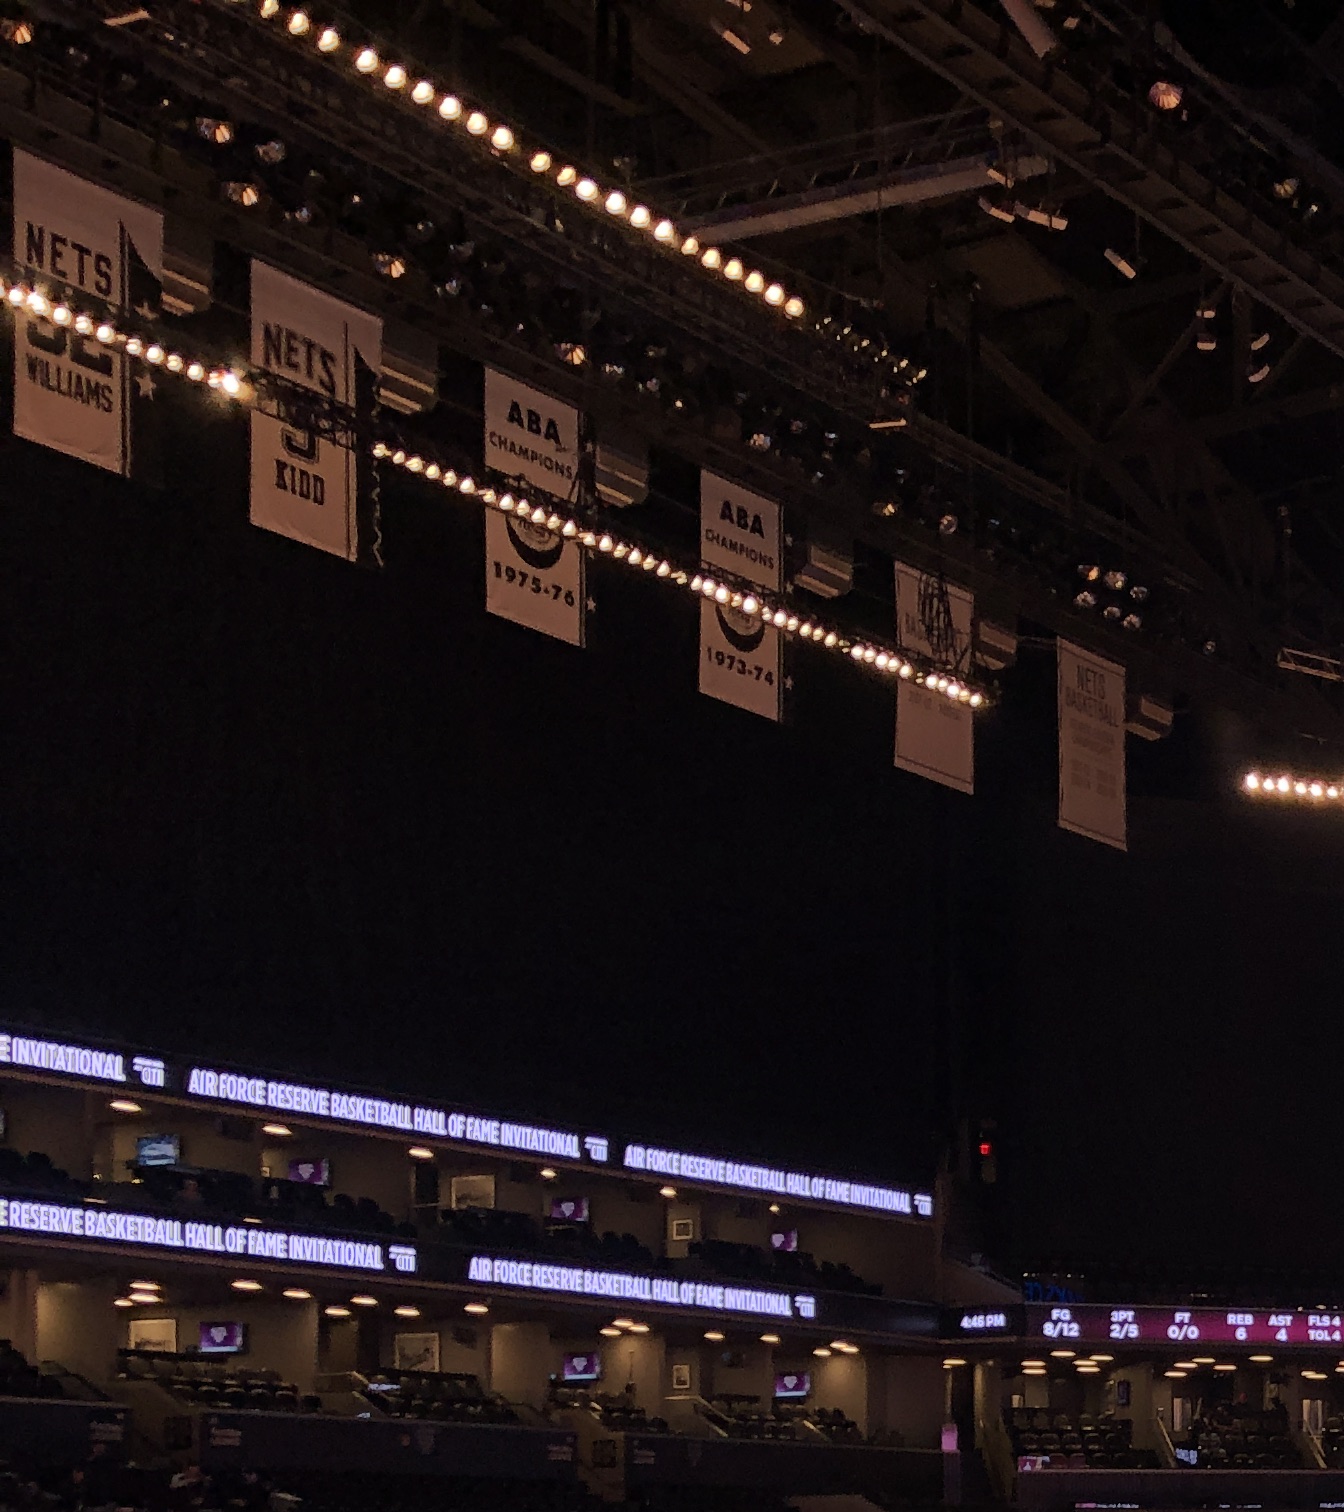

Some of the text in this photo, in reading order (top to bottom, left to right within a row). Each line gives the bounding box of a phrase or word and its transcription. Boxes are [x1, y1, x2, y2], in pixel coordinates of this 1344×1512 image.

[25, 220, 112, 297] NETS
[261, 320, 336, 396] NETS
[25, 349, 114, 413] WILLIAMS
[506, 399, 561, 444] ABA
[489, 430, 574, 481] CHAMPIONS
[274, 458, 326, 506] KIDD
[719, 499, 766, 539] ABA
[705, 527, 775, 571] CHAMPIONS
[492, 560, 576, 607] 1975-76
[706, 646, 775, 687] 1973-74
[11, 1035, 127, 1082] INVITATIONAL
[188, 1067, 581, 1159] AIR FORCE RESERVE BASKETBALL HALL OF FAME INVITATIONAL
[9, 1200, 384, 1271] RESERVE BASKETBALL HALL OF FAME INVITATIONAL
[468, 1256, 652, 1301] AIR FORCE RESERVE BASKETBALL
[985, 1313, 1007, 1328] PM
[1042, 1320, 1081, 1339] 8/12
[1051, 1308, 1071, 1321] FG
[1109, 1322, 1139, 1340] 2/5
[1110, 1310, 1135, 1324] 3PT
[1166, 1323, 1200, 1341] 0/0
[1174, 1311, 1192, 1324] FT
[1227, 1313, 1254, 1326] REB
[1268, 1314, 1293, 1327] AST
[1307, 1328, 1341, 1342] TOL 4
[1308, 1314, 1341, 1327] FLS 4
